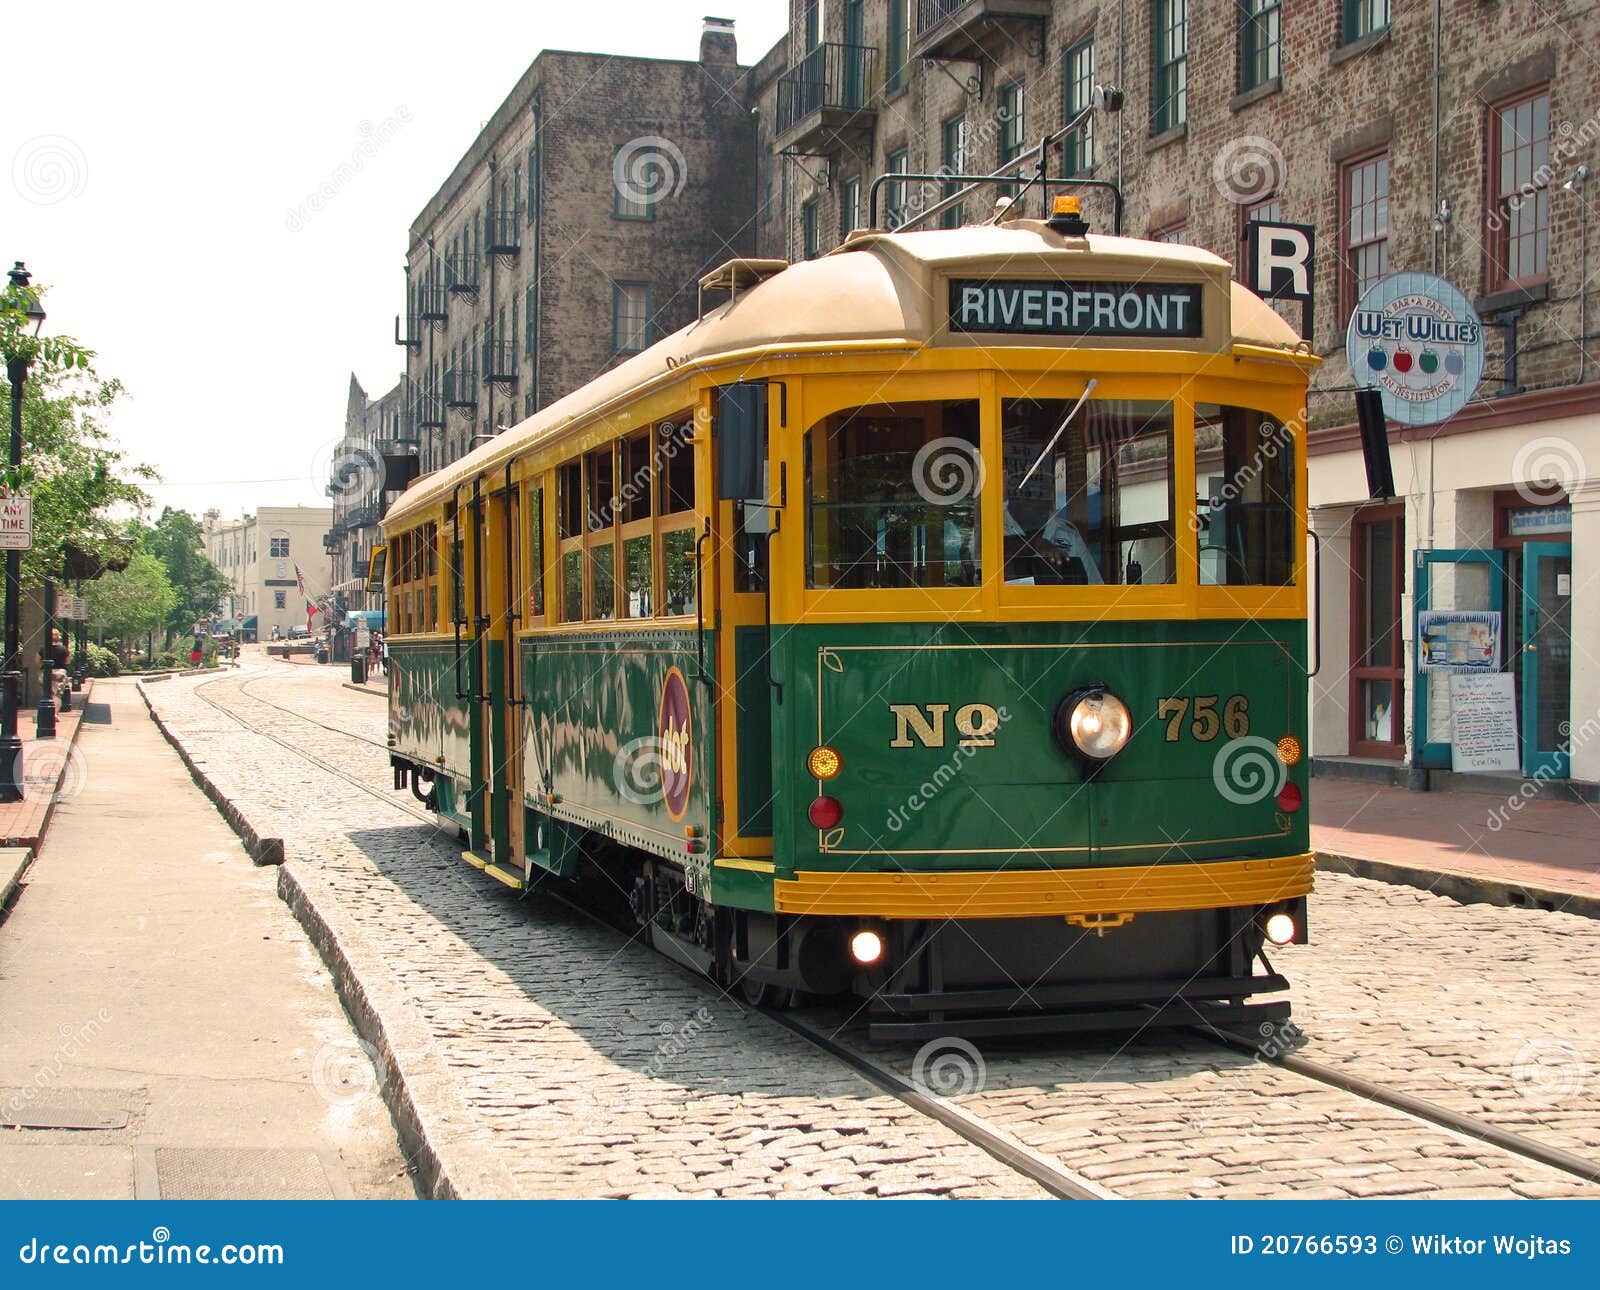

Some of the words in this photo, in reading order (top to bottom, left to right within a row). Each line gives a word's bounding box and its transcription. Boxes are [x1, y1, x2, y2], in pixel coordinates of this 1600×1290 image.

[1258, 226, 1310, 295] R
[962, 287, 1191, 331] RIVERFRONT
[1393, 298, 1410, 310] BAR
[1426, 300, 1452, 319] PARTY
[1407, 315, 1479, 342] WILLIE'S
[1381, 375, 1394, 388] AN
[1394, 379, 1452, 400] INSTITUTION
[1, 519, 25, 530] TIME
[4, 506, 23, 517] ANY
[1157, 694, 1251, 743] 756
[663, 715, 689, 775] dot
